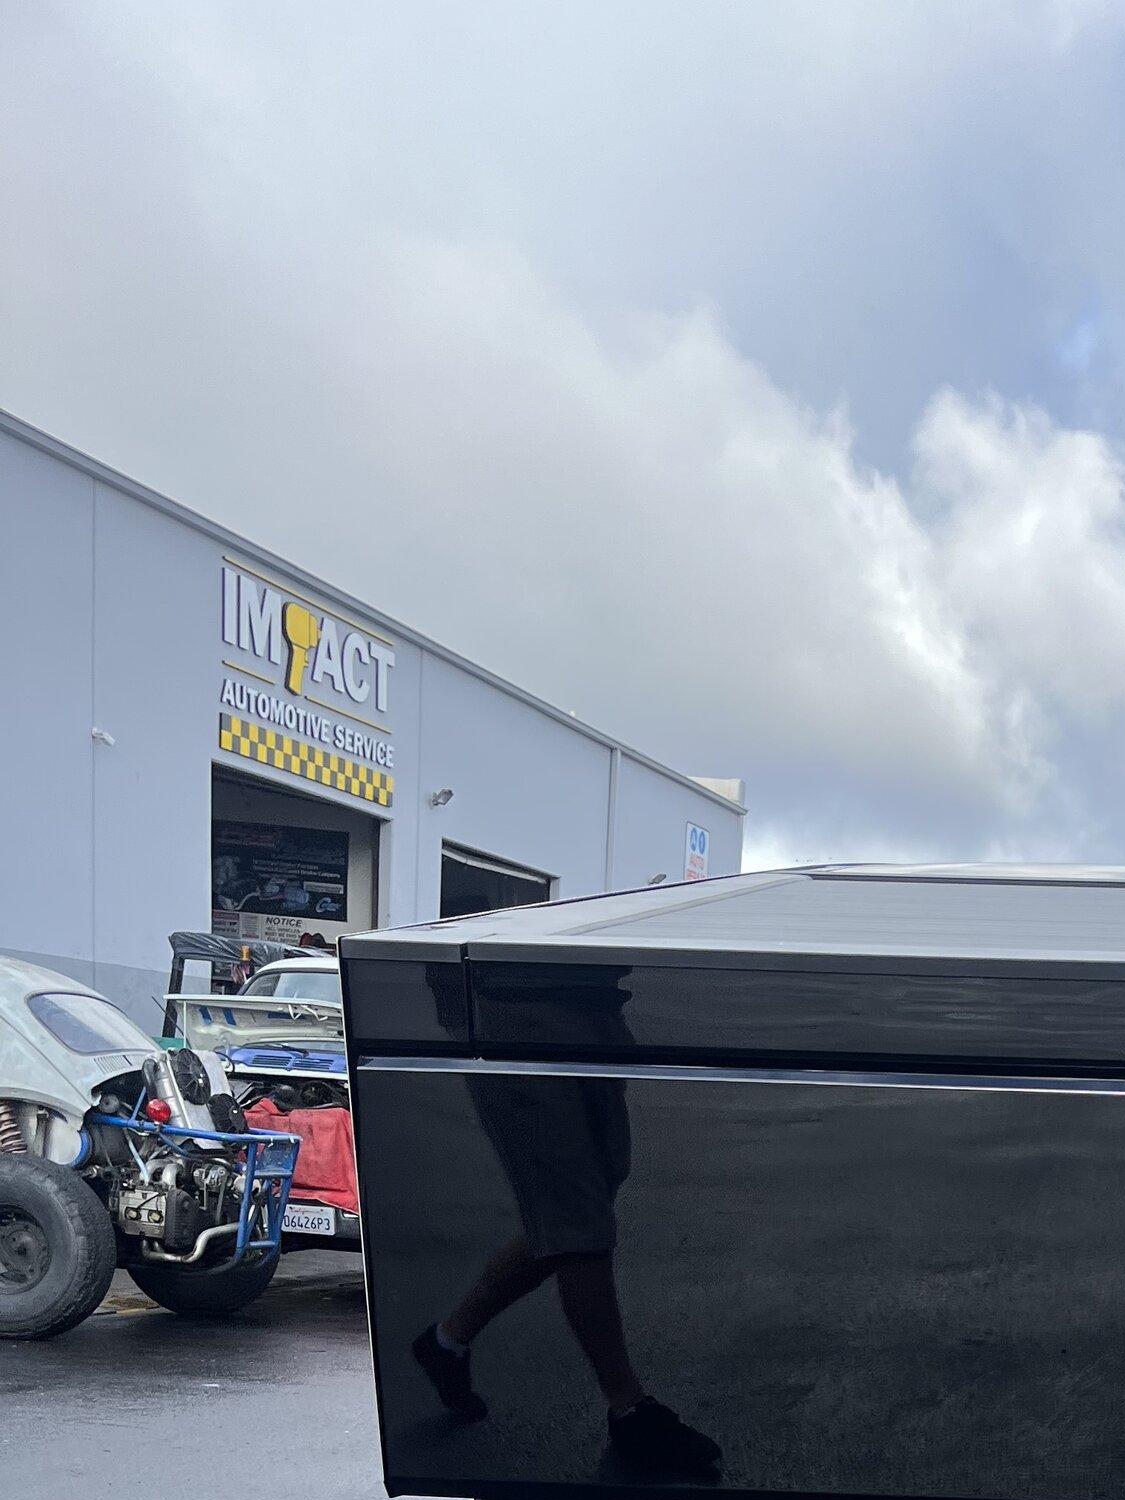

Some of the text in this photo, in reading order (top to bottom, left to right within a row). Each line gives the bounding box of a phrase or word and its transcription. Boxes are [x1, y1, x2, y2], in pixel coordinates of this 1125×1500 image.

[221, 679, 395, 769] AUTOMOTIVE SERVICE
[266, 917, 303, 927] NOTICE
